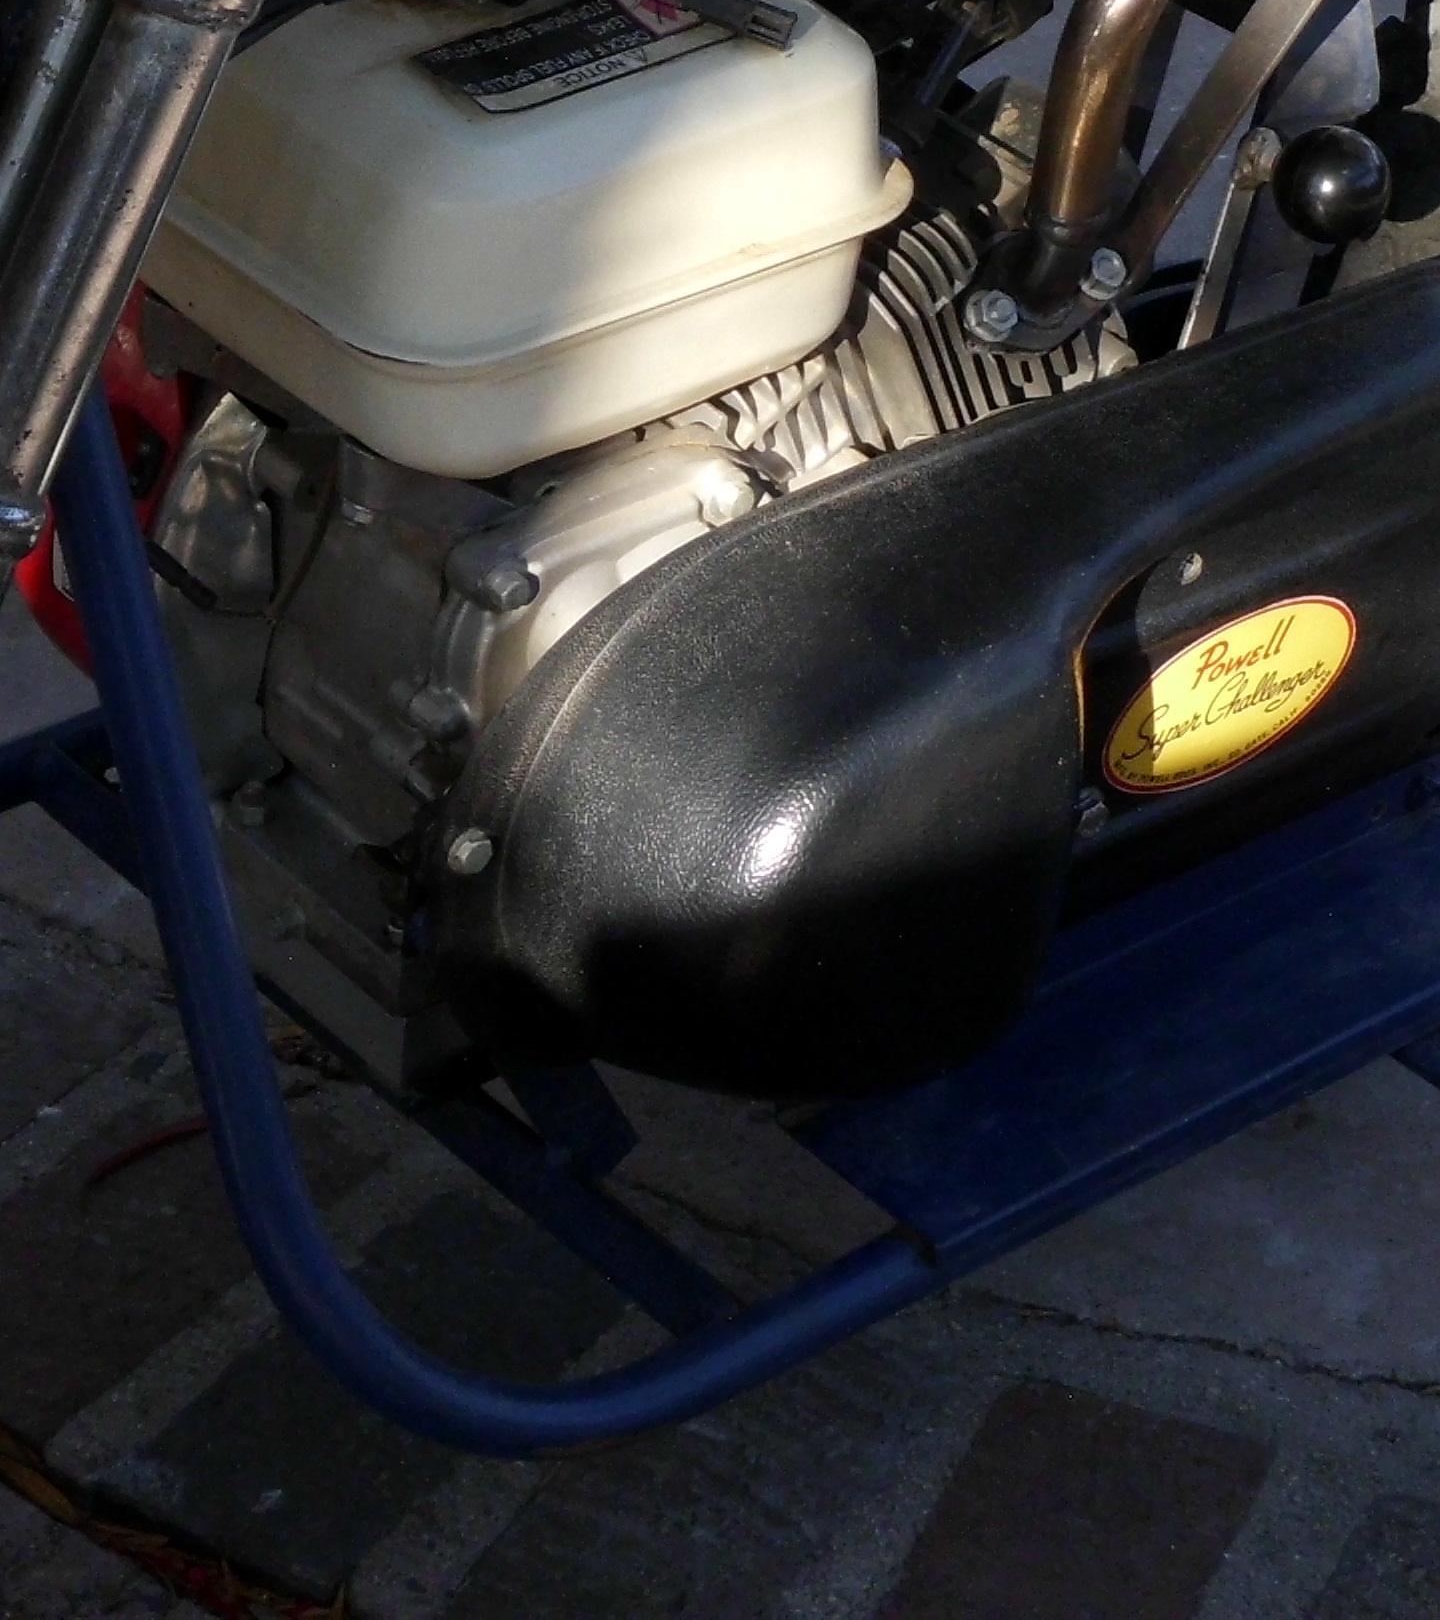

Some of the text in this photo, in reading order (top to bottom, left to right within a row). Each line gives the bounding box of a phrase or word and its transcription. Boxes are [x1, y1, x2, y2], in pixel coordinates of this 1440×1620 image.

[553, 59, 626, 88] NOTICE
[1191, 615, 1296, 690] Powell
[1121, 703, 1205, 761] Super
[1205, 660, 1326, 725] Challenger
